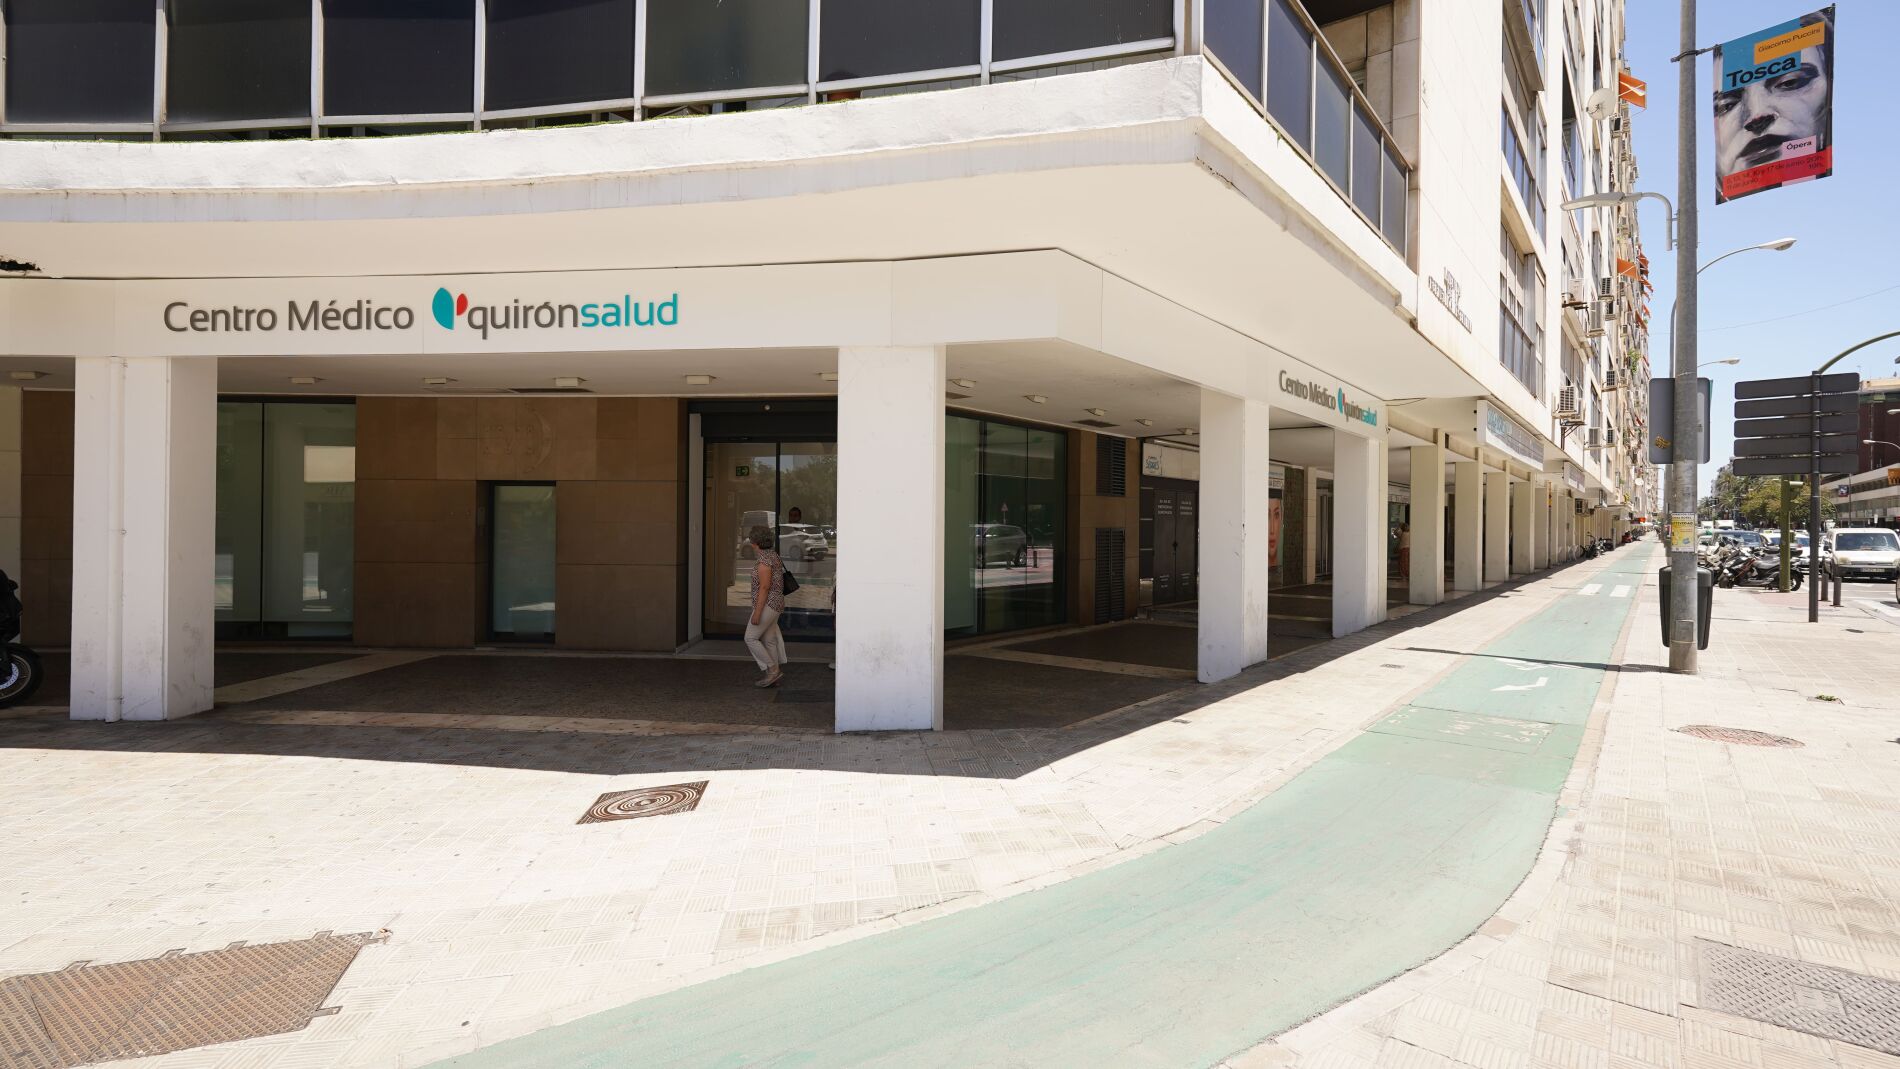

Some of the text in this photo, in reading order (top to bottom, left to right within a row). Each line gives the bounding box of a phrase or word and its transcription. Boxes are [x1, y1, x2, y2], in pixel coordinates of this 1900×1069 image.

[1758, 27, 1821, 53] Giacomo Puccini
[1726, 56, 1797, 88] Tosca
[1786, 140, 1812, 151] Ópera
[163, 293, 679, 340] Centro Médico quirónsalud
[1279, 369, 1377, 427] Centro Médico quirónsalud
